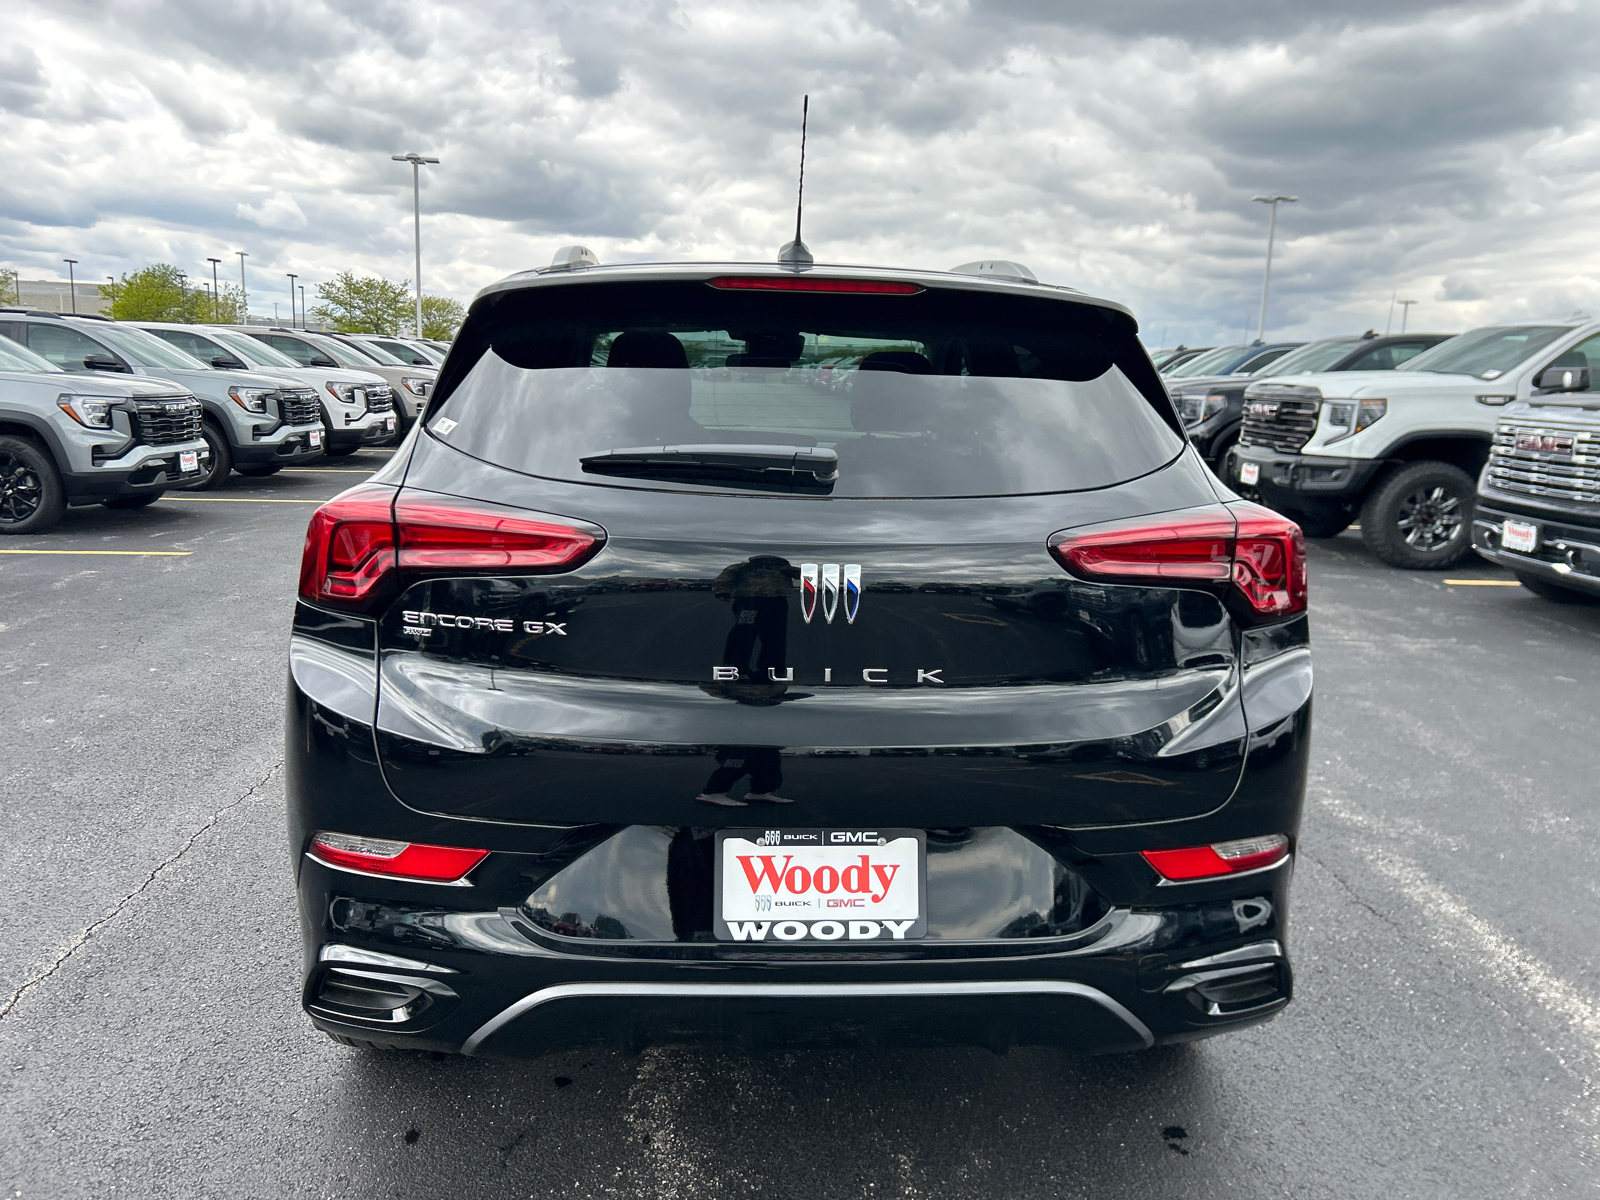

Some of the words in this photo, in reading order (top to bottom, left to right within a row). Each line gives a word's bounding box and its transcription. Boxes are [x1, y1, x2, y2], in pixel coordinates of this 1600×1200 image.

[1516, 435, 1573, 454] GMC
[402, 611, 514, 632] ENCORE
[522, 620, 568, 636] GX
[402, 625, 432, 637] AWD
[712, 666, 945, 684] BUICK
[830, 831, 878, 843] GMC
[736, 855, 900, 903] Woody
[826, 898, 865, 908] GMC
[726, 920, 915, 940] WOODY
